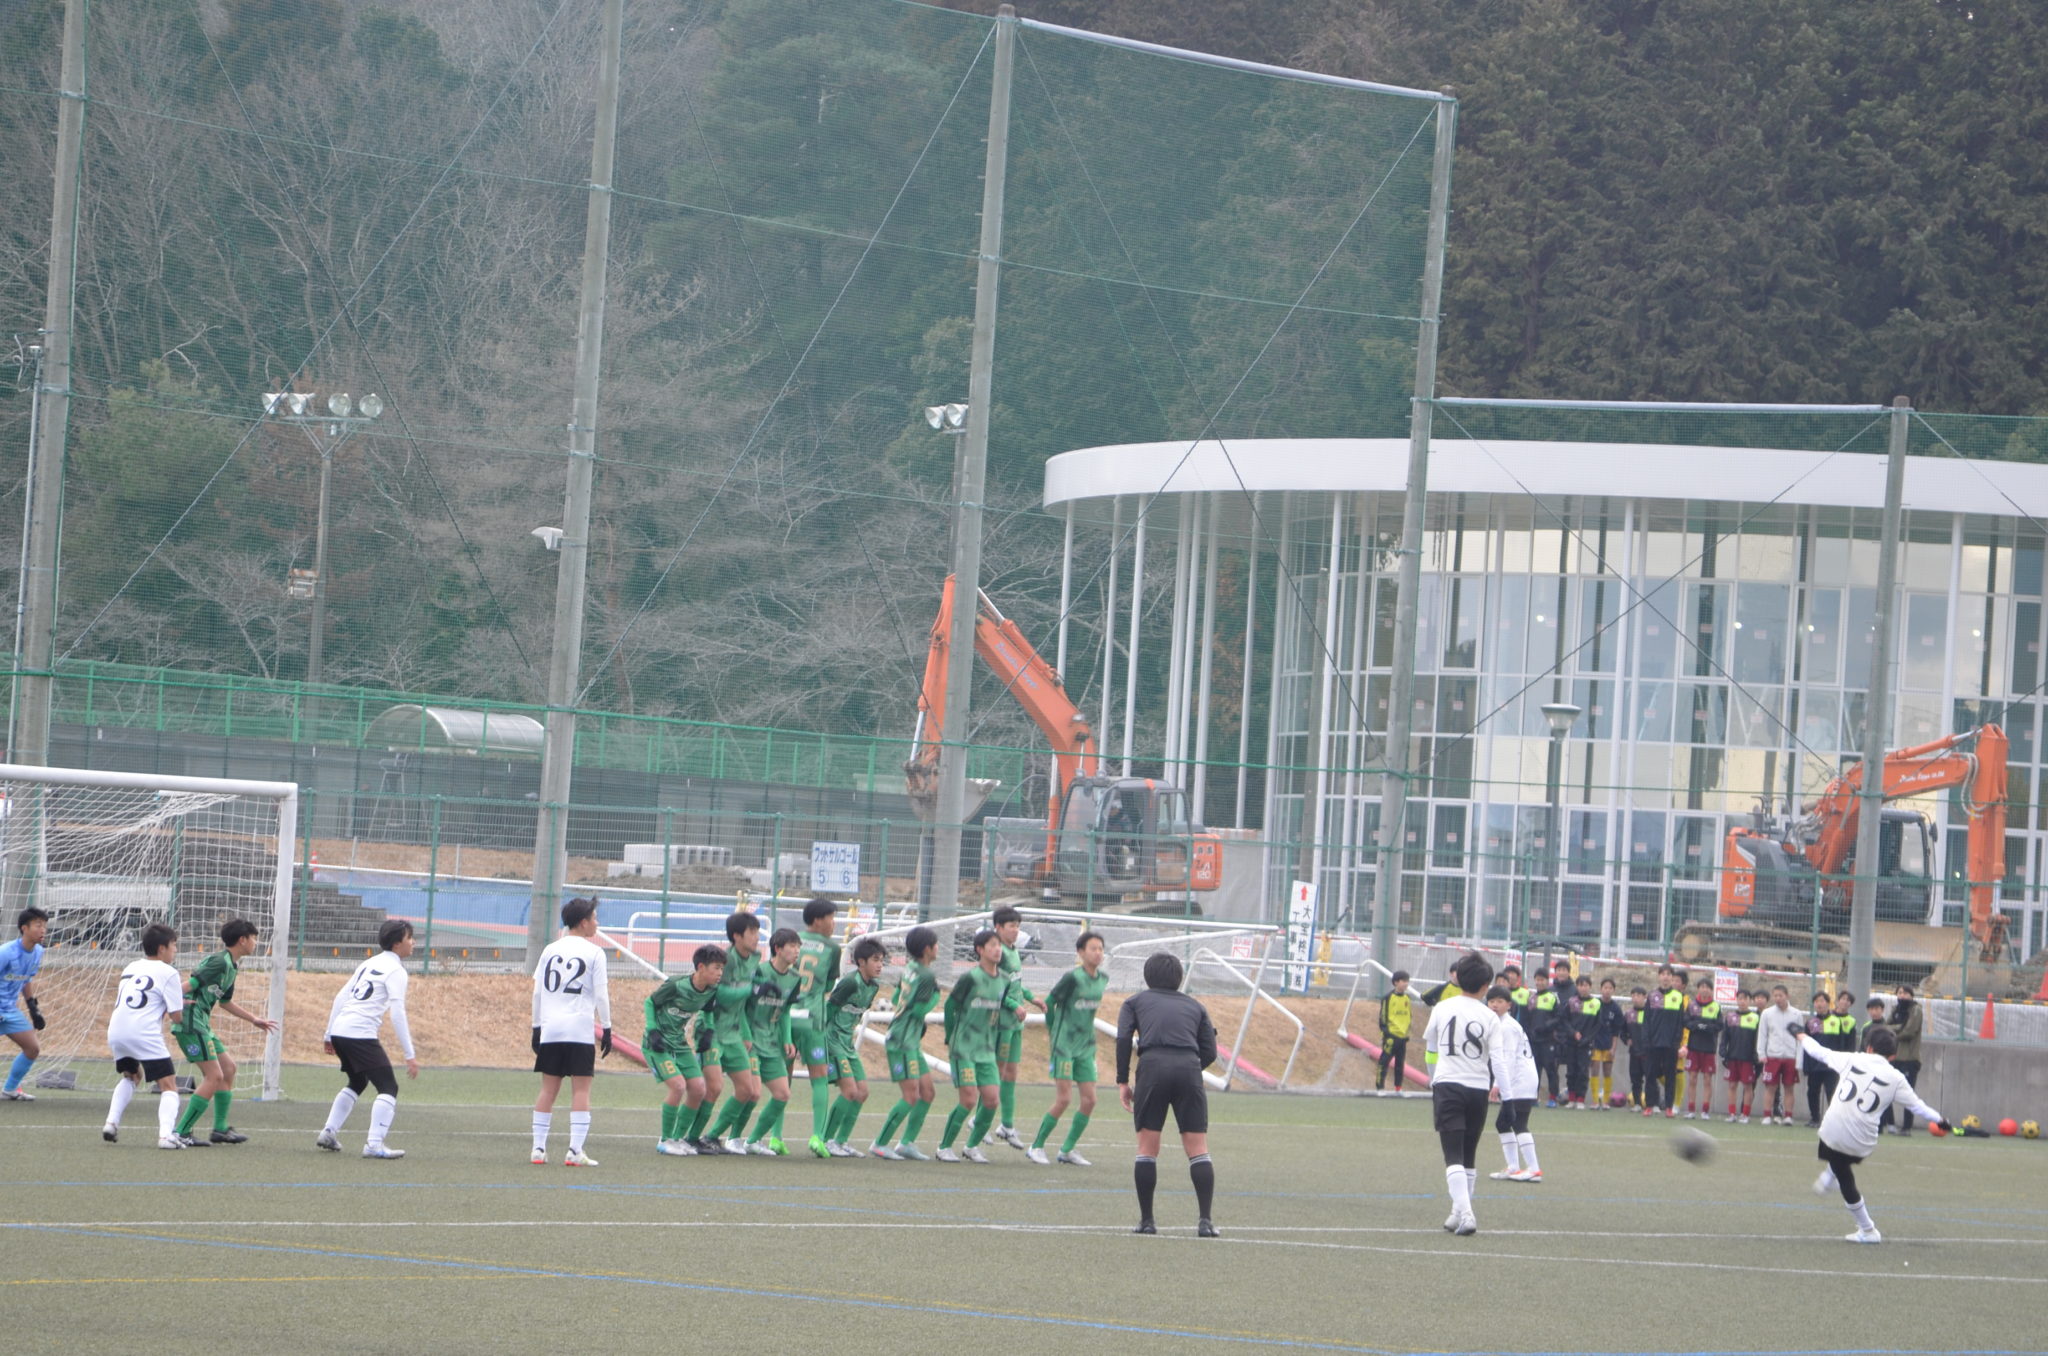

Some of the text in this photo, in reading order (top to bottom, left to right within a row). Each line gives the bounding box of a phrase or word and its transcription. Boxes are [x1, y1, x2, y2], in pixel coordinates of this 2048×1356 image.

[818, 869, 851, 886] 5 6
[114, 973, 155, 1010] 73
[543, 953, 587, 995] 62
[799, 953, 818, 993] 5
[1440, 1015, 1485, 1060] 48
[841, 1059, 851, 1074] 3
[1838, 1065, 1890, 1114] 55
